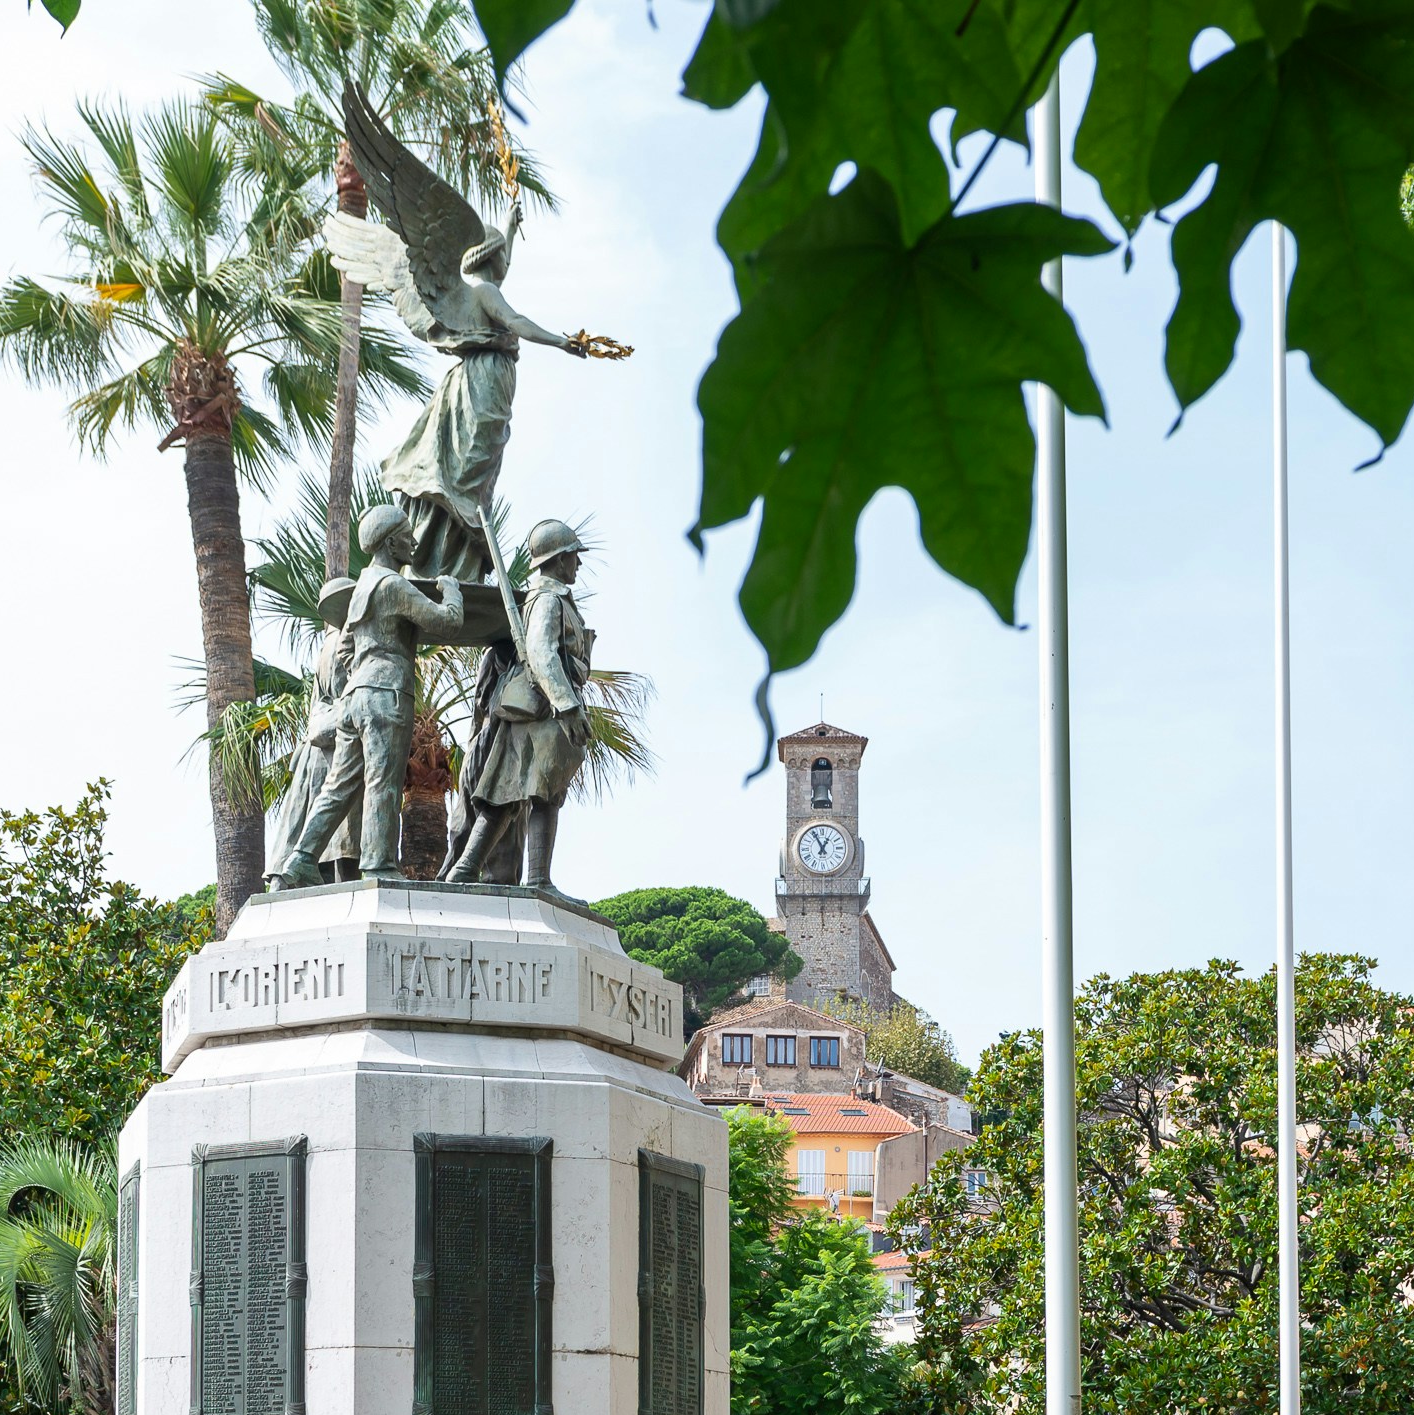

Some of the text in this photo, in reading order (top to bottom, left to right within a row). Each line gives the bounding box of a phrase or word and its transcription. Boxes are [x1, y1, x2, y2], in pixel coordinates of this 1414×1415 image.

[211, 957, 346, 1013] L'ORIENT
[392, 953, 553, 1004] LA MARNE
[591, 970, 672, 1039] L'YSER
